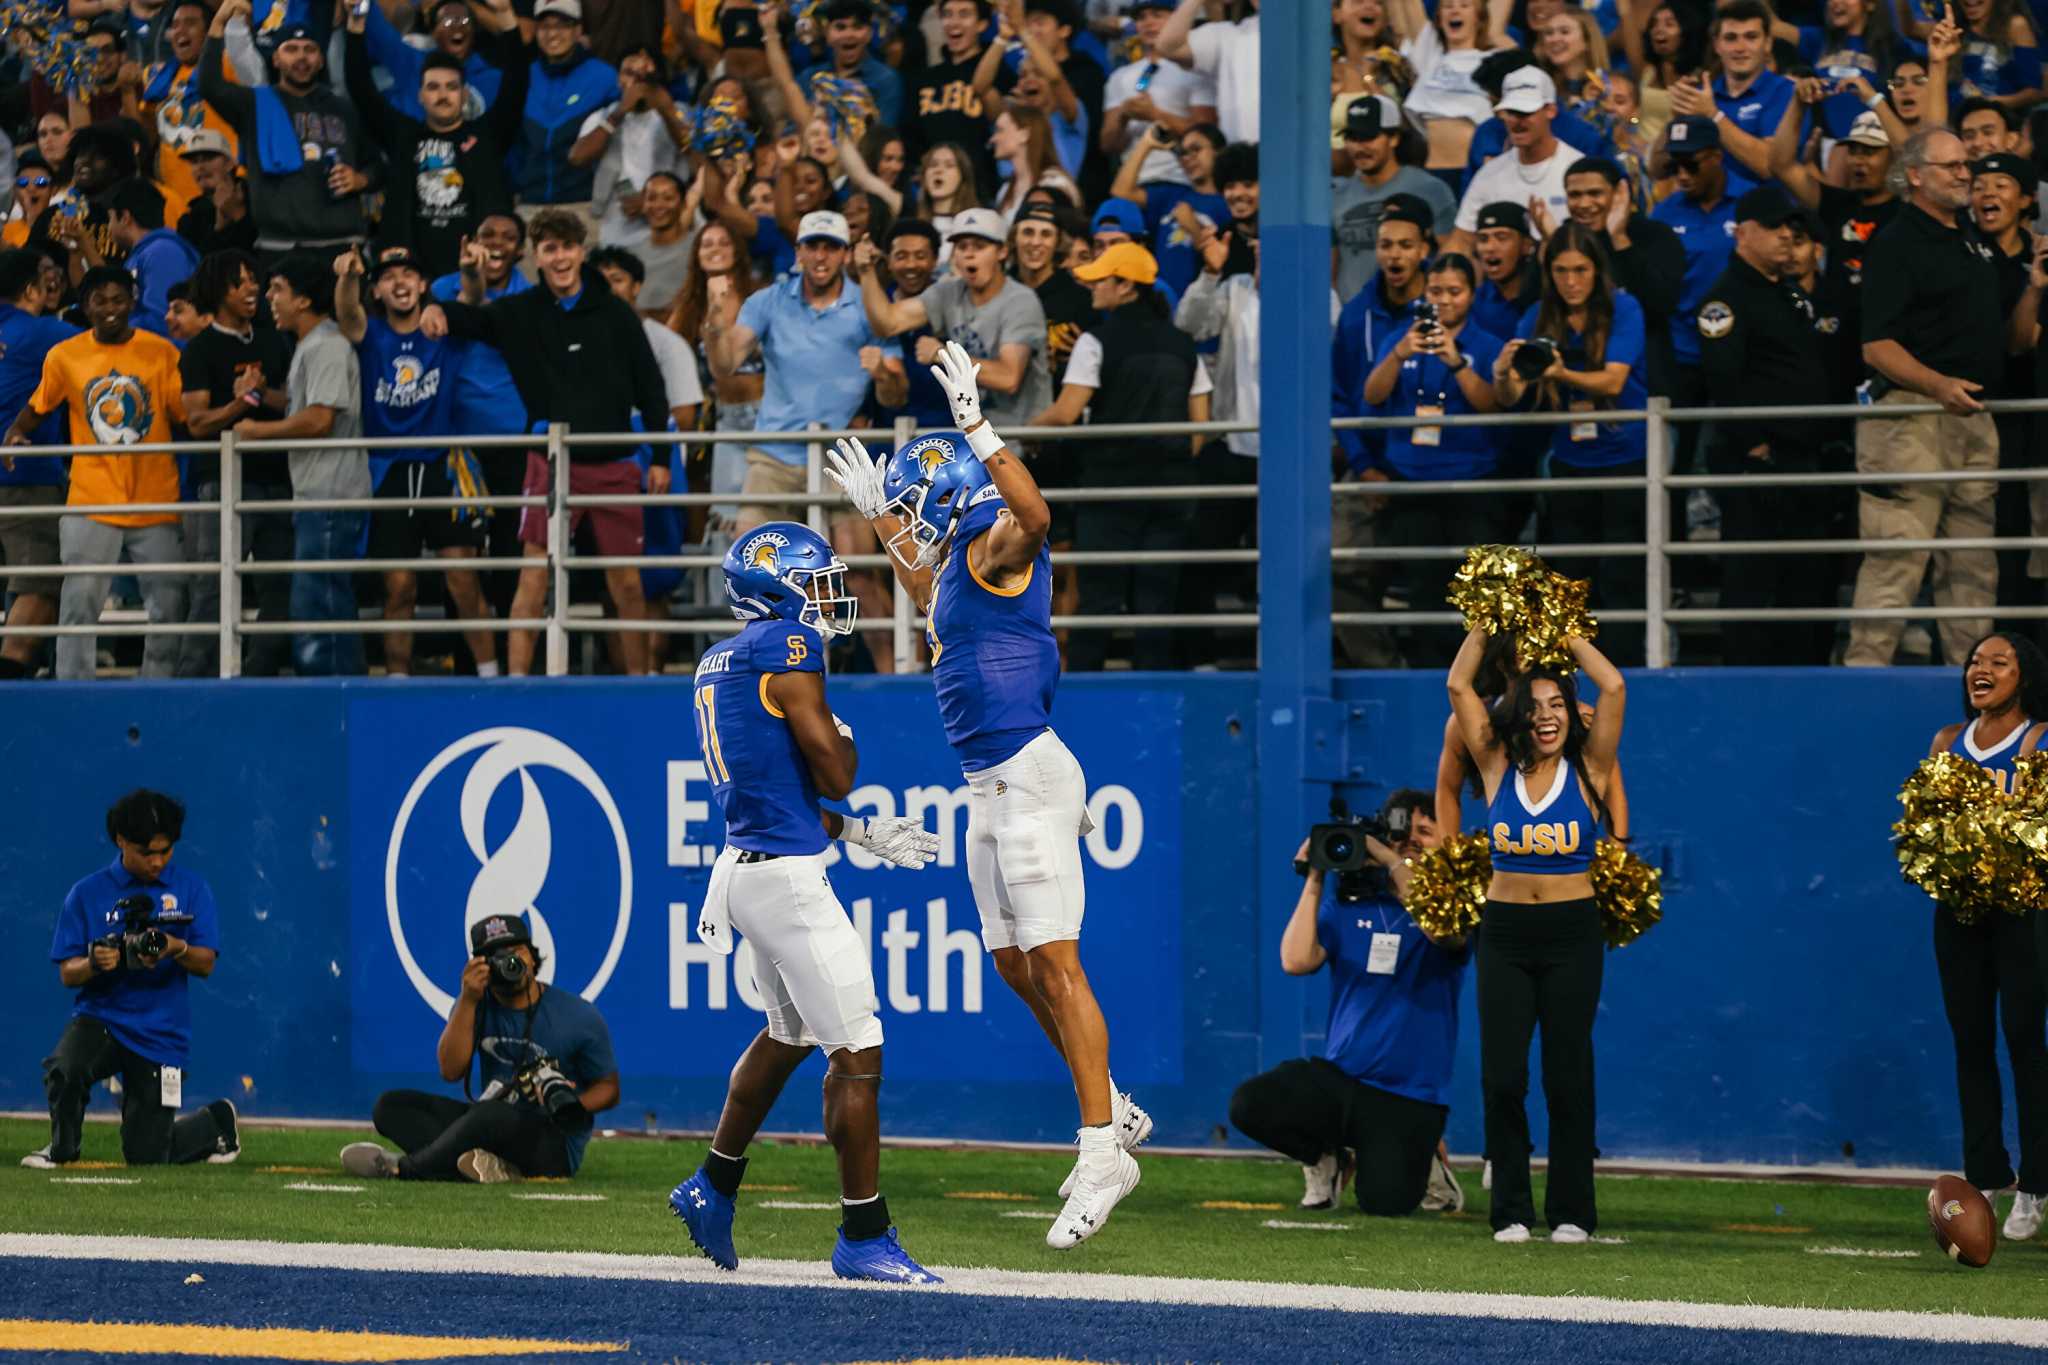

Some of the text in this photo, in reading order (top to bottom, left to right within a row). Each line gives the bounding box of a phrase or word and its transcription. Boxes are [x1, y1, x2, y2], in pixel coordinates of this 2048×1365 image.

[982, 489, 996, 499] SAN
[695, 684, 731, 786] 11
[667, 760, 1144, 869] E amo
[1493, 821, 1580, 855] SJSU
[669, 898, 983, 1013] Hlth
